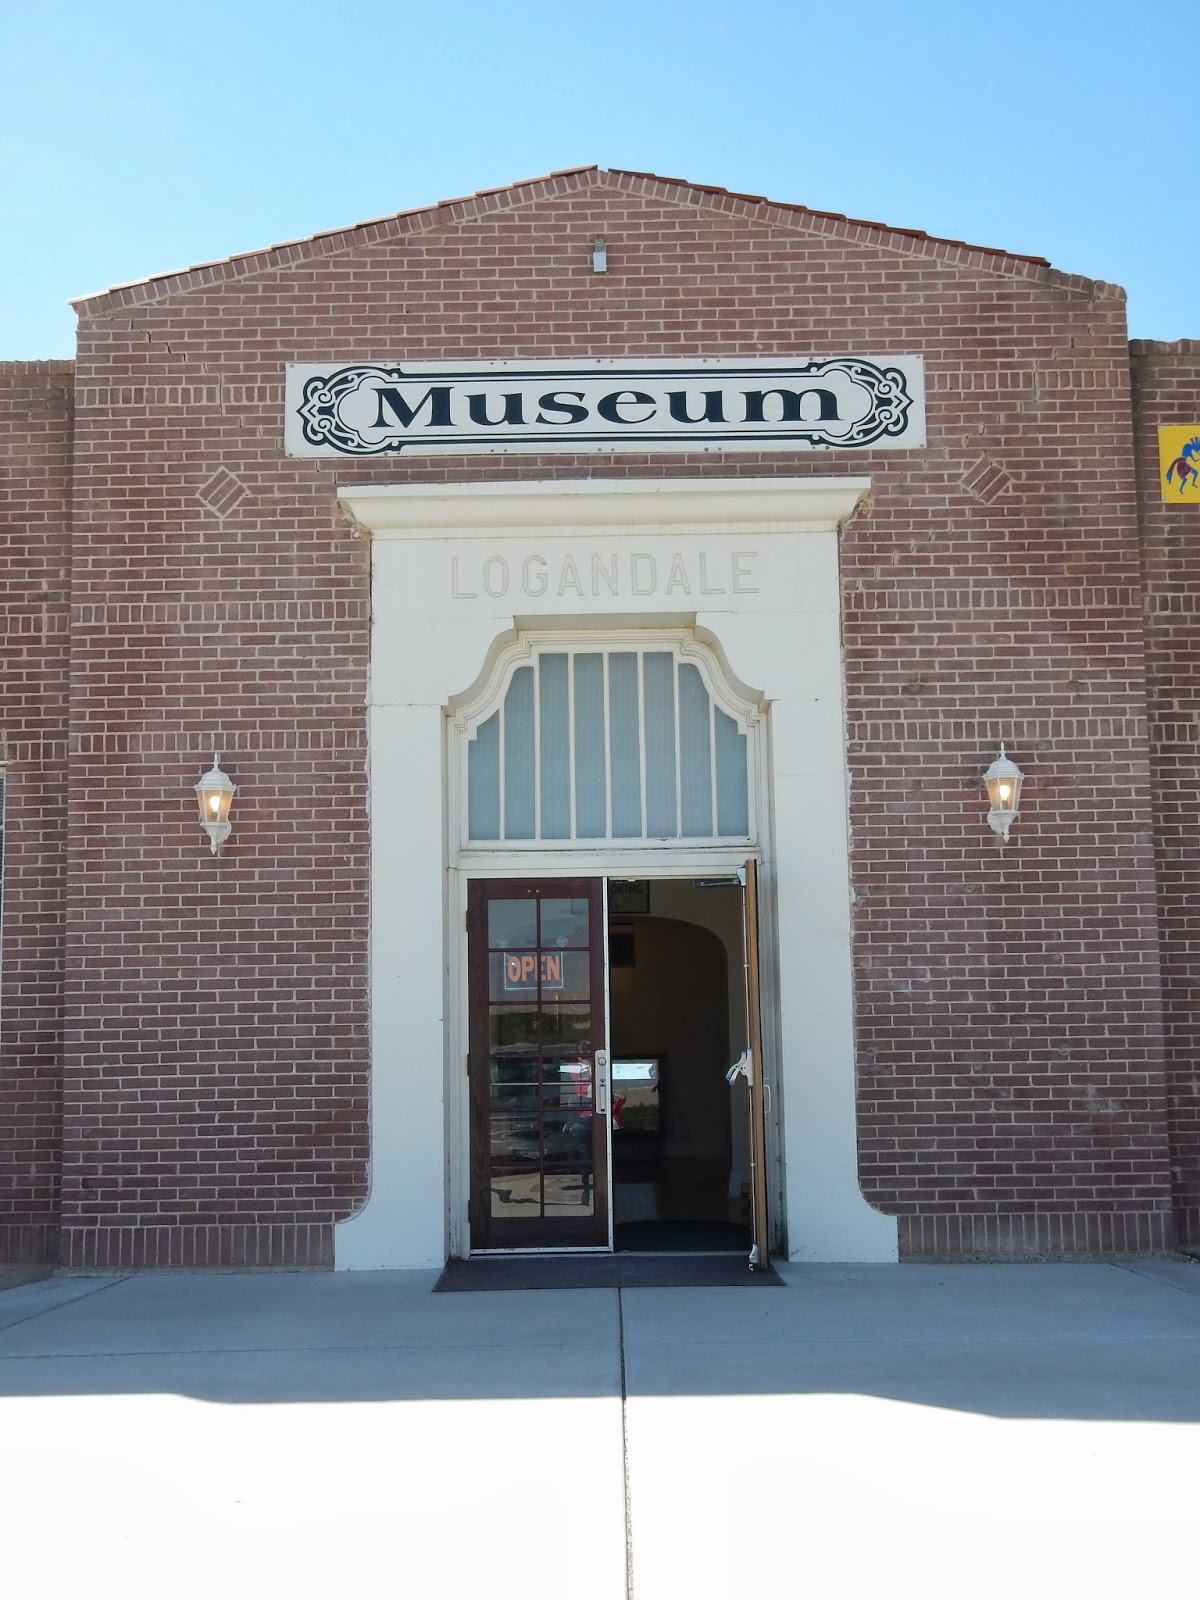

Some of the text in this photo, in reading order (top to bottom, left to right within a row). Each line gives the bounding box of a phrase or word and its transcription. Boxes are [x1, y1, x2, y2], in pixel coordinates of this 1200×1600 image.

[368, 385, 846, 428] Museum
[451, 552, 760, 599] LOGANDALE
[610, 883, 644, 895] OKING
[507, 955, 560, 982] OPEN
